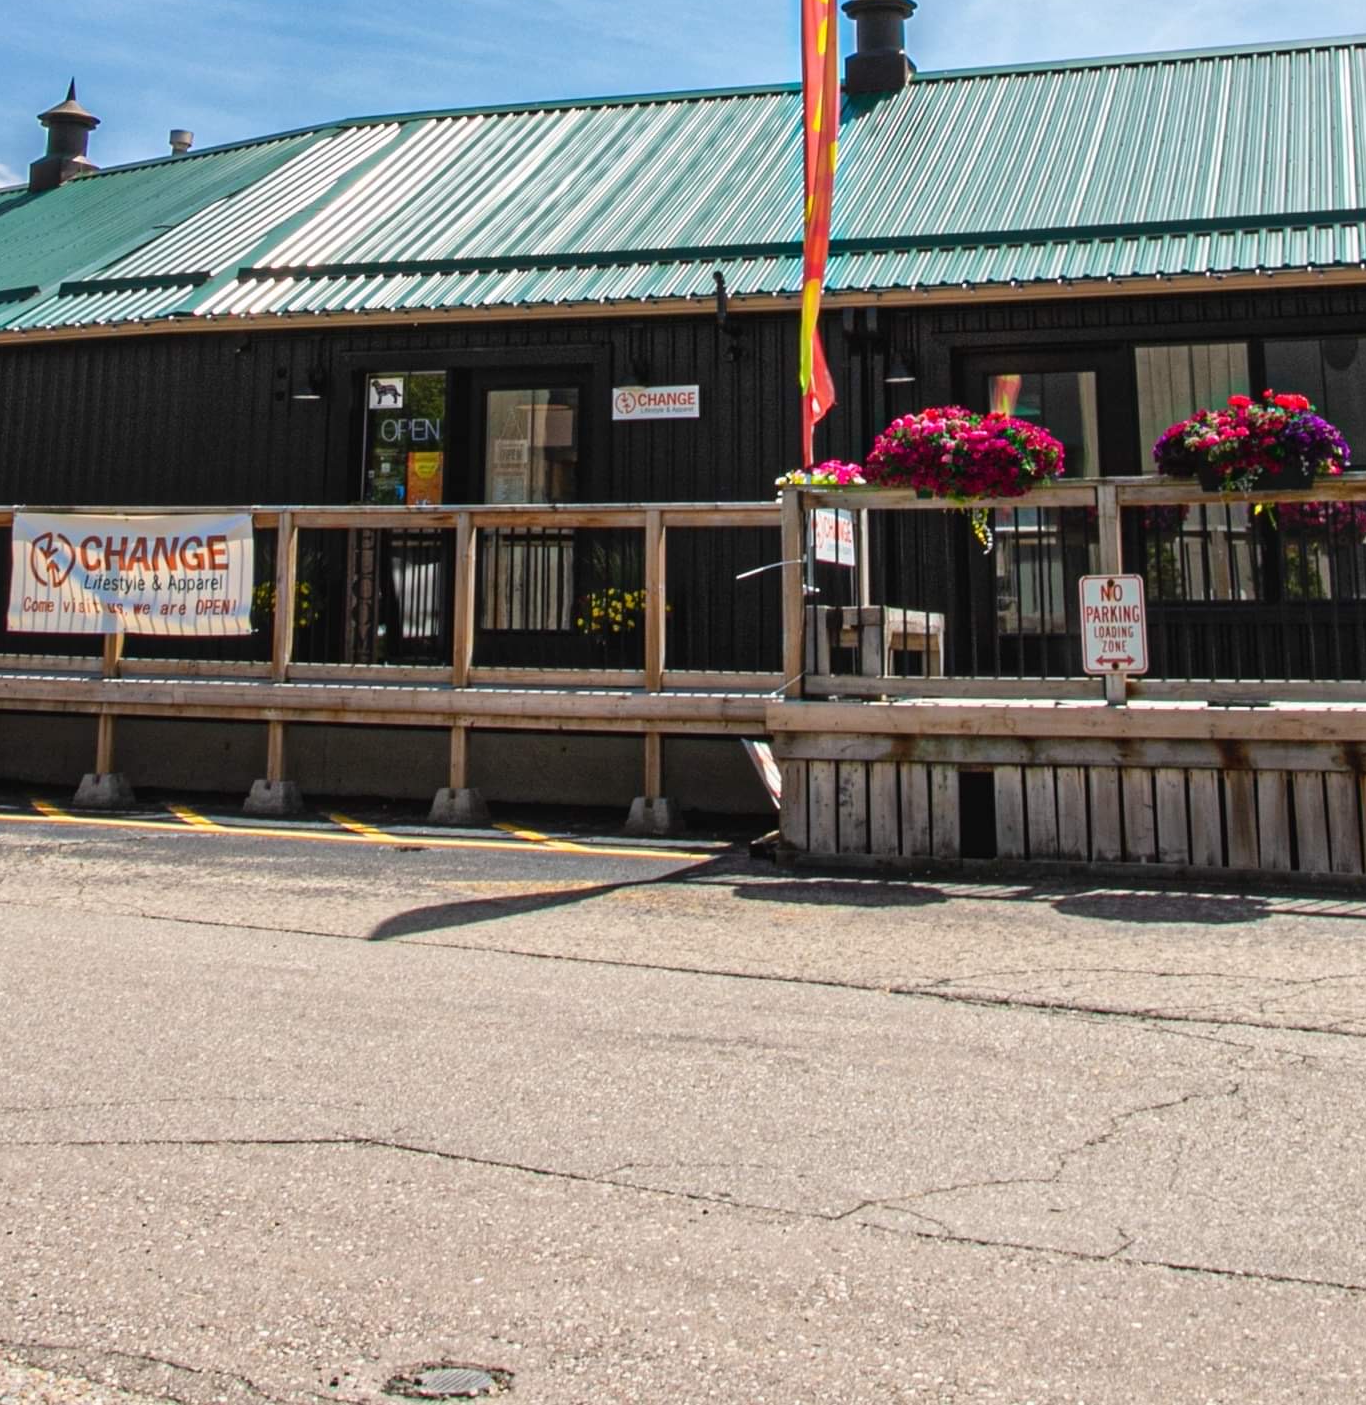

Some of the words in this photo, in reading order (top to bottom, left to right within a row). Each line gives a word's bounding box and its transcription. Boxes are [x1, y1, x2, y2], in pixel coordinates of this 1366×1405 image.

[637, 392, 695, 407] CHANGE
[380, 418, 441, 442] OPEN
[80, 535, 229, 571] CHANGE
[84, 574, 146, 594] Lifestyle
[152, 574, 163, 590] &
[168, 574, 223, 593] Apparel
[1100, 584, 1123, 602] NO
[23, 596, 55, 613] Come
[63, 597, 101, 613] visit
[134, 602, 152, 614] we
[160, 603, 186, 615] are
[195, 599, 237, 615] OPEN!
[1086, 605, 1140, 624] PARKING
[1094, 626, 1134, 638] LOADING
[1102, 640, 1127, 653] ZONE
